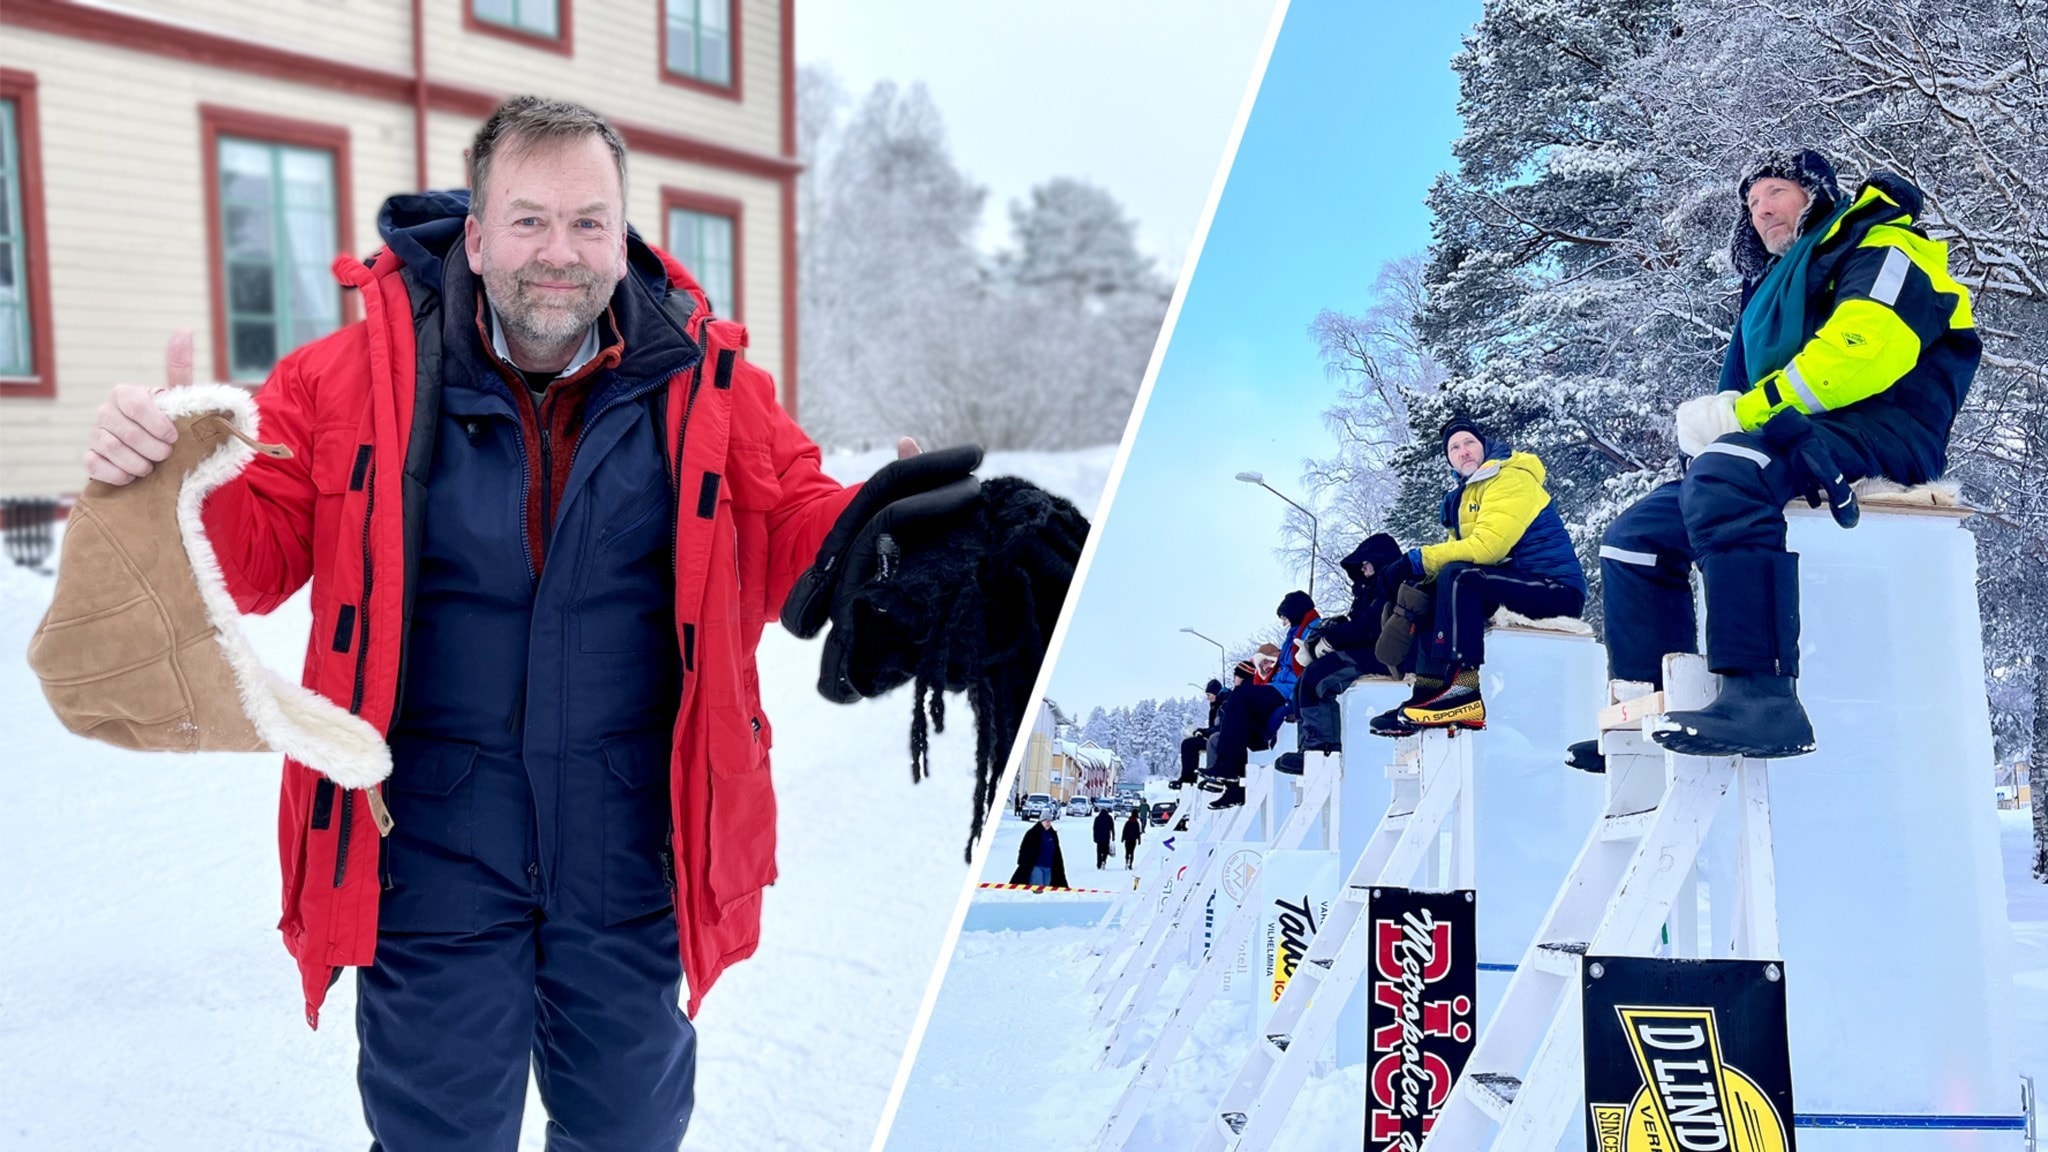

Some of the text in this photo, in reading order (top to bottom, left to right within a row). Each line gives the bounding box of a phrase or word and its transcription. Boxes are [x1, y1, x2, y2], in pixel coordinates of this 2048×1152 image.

[1237, 935, 1249, 973] otell
[1266, 922, 1276, 977] VILHELMINA
[1394, 907, 1437, 1119] Metropolen
[1638, 1024, 1705, 1050] D
[1598, 1111, 1621, 1152] SINCE
[1640, 1105, 1663, 1152] VER
